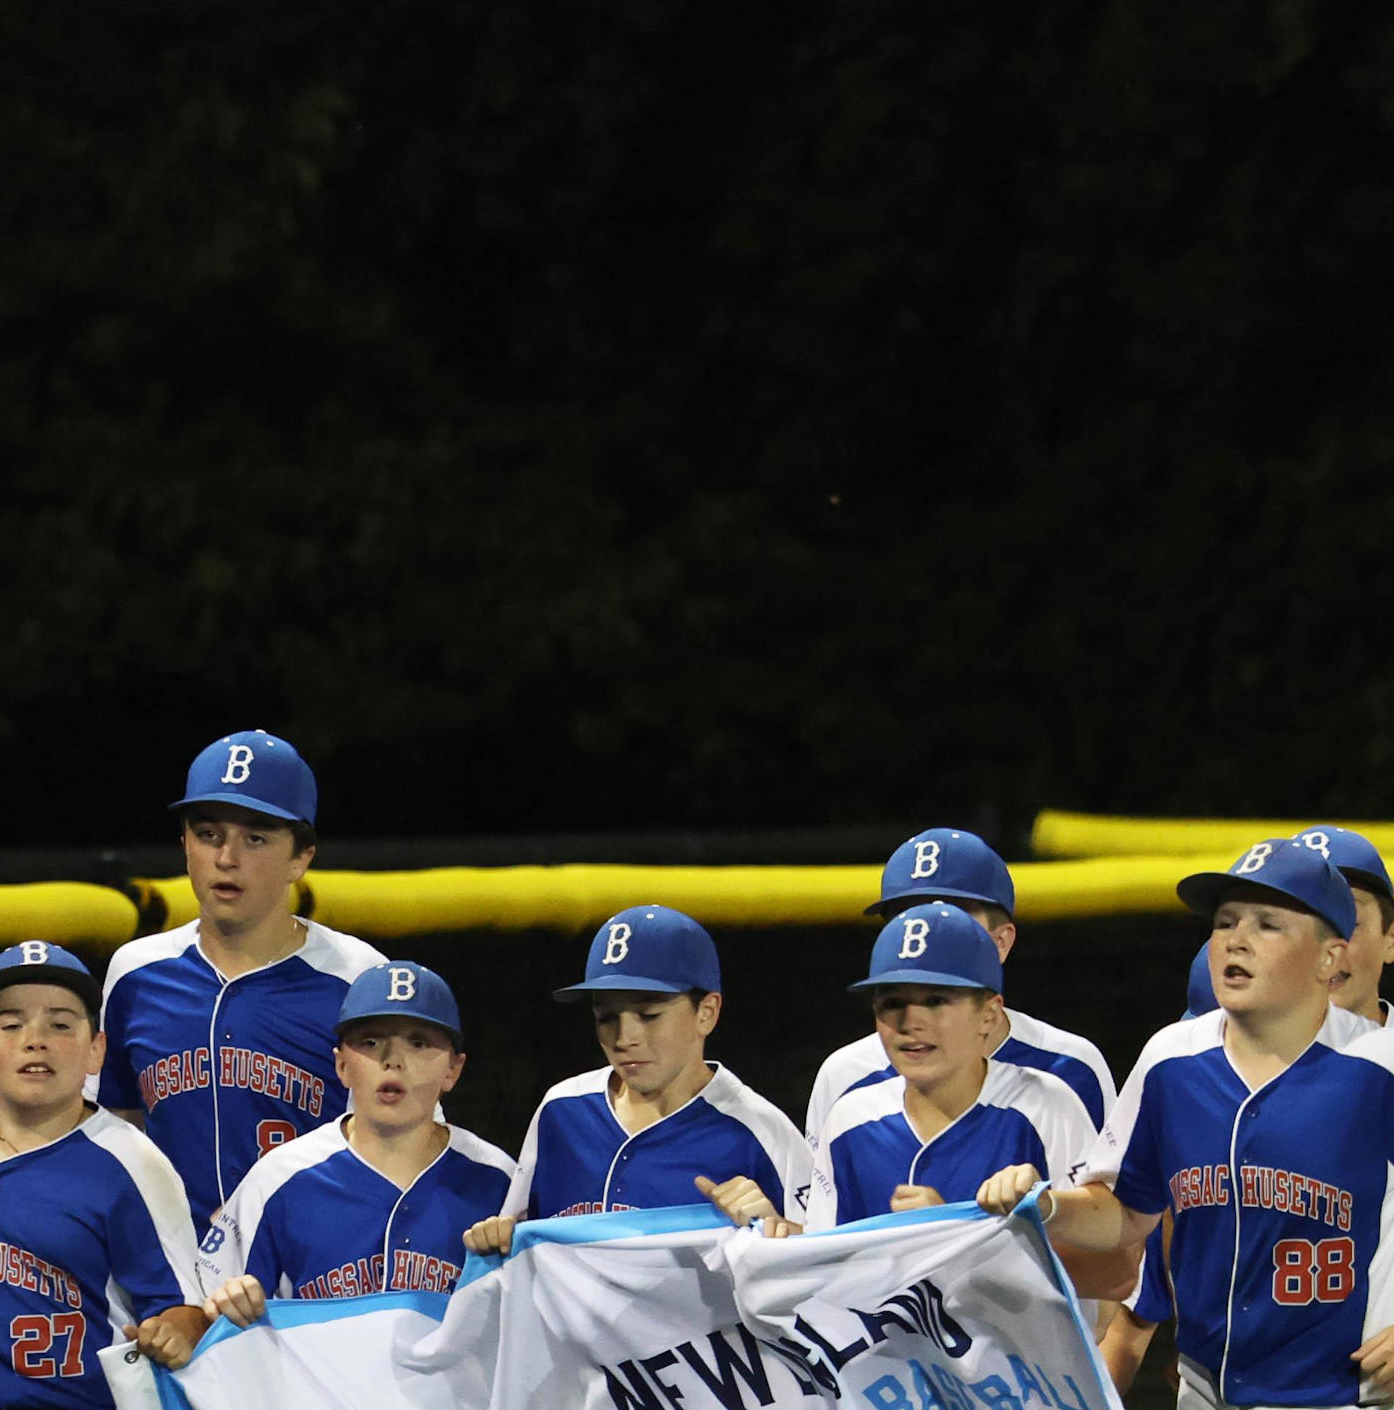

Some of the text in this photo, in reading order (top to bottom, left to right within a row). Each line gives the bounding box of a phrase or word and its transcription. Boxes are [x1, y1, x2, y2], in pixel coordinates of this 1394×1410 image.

[221, 745, 254, 784] B
[910, 841, 941, 879] B
[1236, 843, 1273, 875] B
[19, 940, 49, 966] B
[602, 923, 632, 965] B
[898, 918, 931, 959] B
[386, 967, 417, 1002] B
[1272, 1236, 1355, 1306] 88
[9, 1310, 87, 1379] 27
